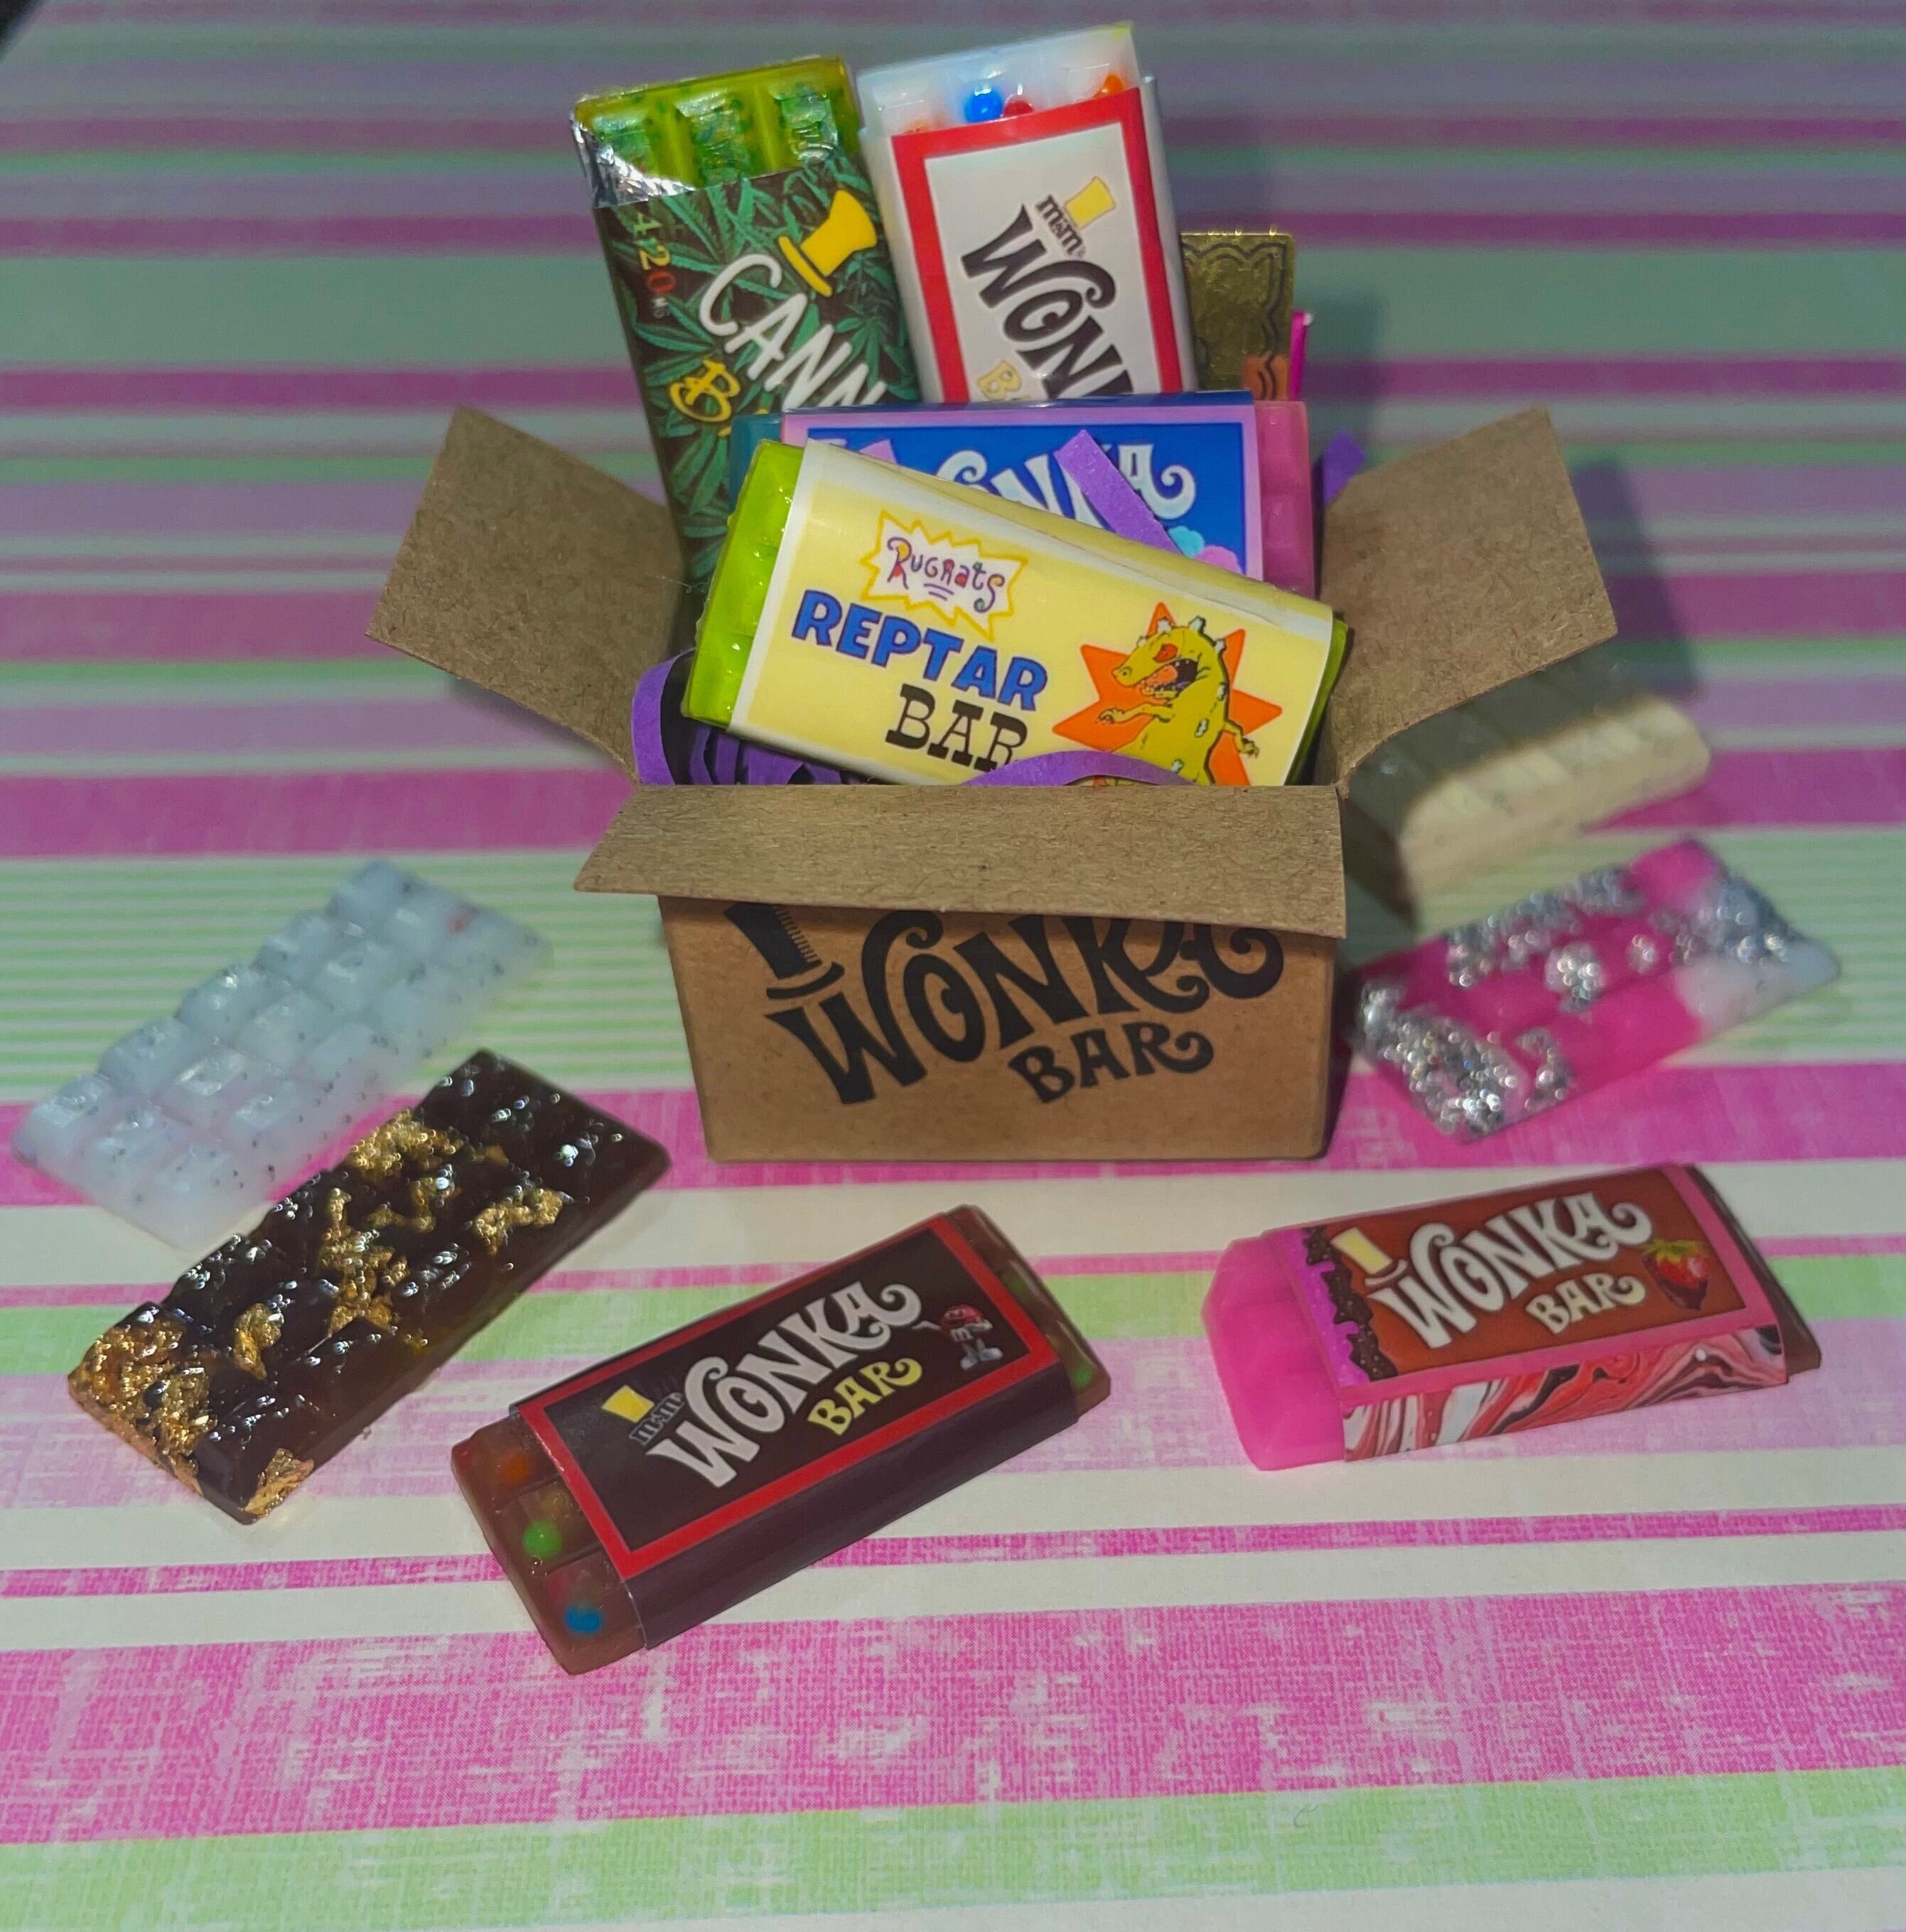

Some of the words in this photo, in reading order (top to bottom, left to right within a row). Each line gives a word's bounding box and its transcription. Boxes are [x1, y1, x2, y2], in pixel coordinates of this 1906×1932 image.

[633, 212, 676, 293] 420
[791, 590, 1048, 712] REPTAR
[885, 683, 1028, 772] BAR
[766, 910, 1284, 1105] WONKA
[1008, 1021, 1214, 1104] BAR
[1369, 1190, 1653, 1349] WONKA
[1526, 1271, 1646, 1334] BAR
[646, 1280, 922, 1488] WONKA
[808, 1357, 923, 1436] BAR
